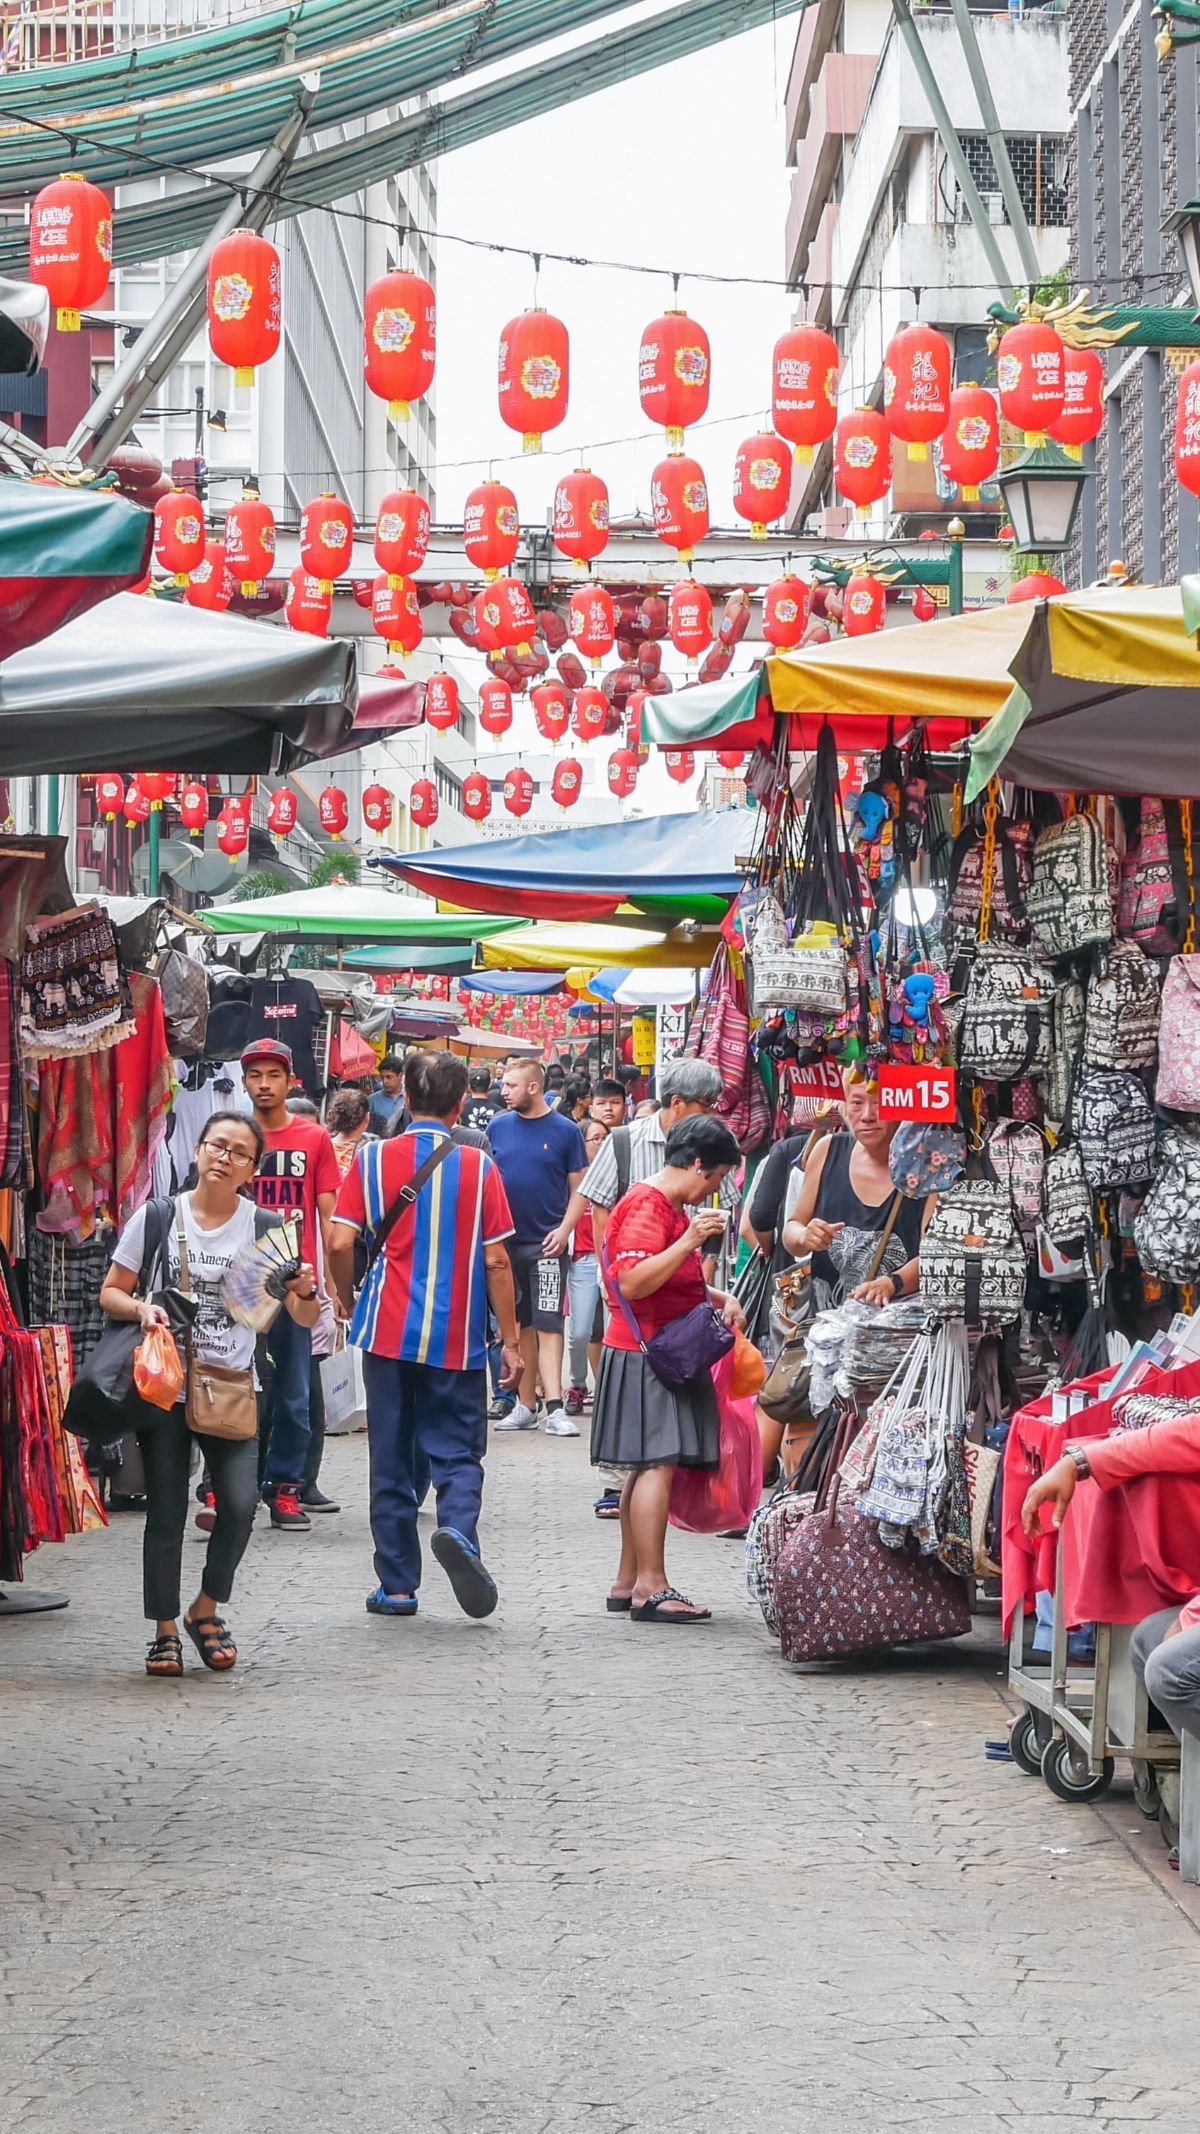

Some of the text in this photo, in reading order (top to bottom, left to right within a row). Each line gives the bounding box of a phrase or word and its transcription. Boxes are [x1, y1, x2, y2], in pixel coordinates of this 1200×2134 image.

[40, 228, 68, 246] KEE
[779, 375, 808, 389] KEE
[1036, 370, 1060, 385] KEE
[789, 1061, 841, 1088] RM 15
[881, 1080, 950, 1109] RM 15
